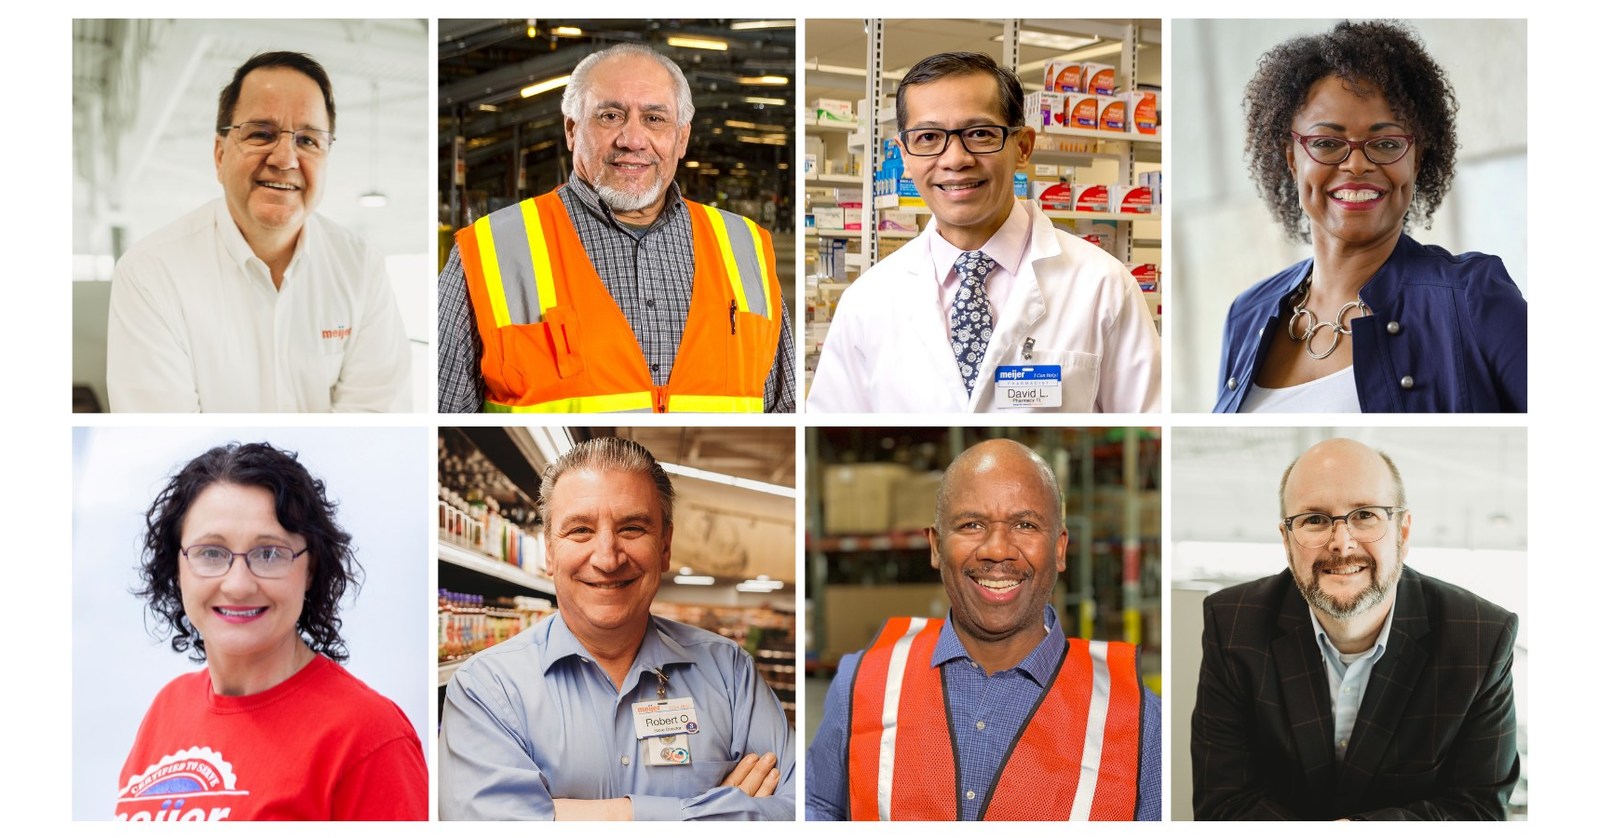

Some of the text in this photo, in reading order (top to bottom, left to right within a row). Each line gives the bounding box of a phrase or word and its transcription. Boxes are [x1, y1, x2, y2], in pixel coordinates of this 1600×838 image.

[1000, 370, 1025, 380] meijer
[1008, 388, 1049, 398] David L.
[645, 717, 677, 726] Robert
[131, 761, 220, 794] CERTIFIED TO SERVE
[114, 798, 231, 821] eijer
